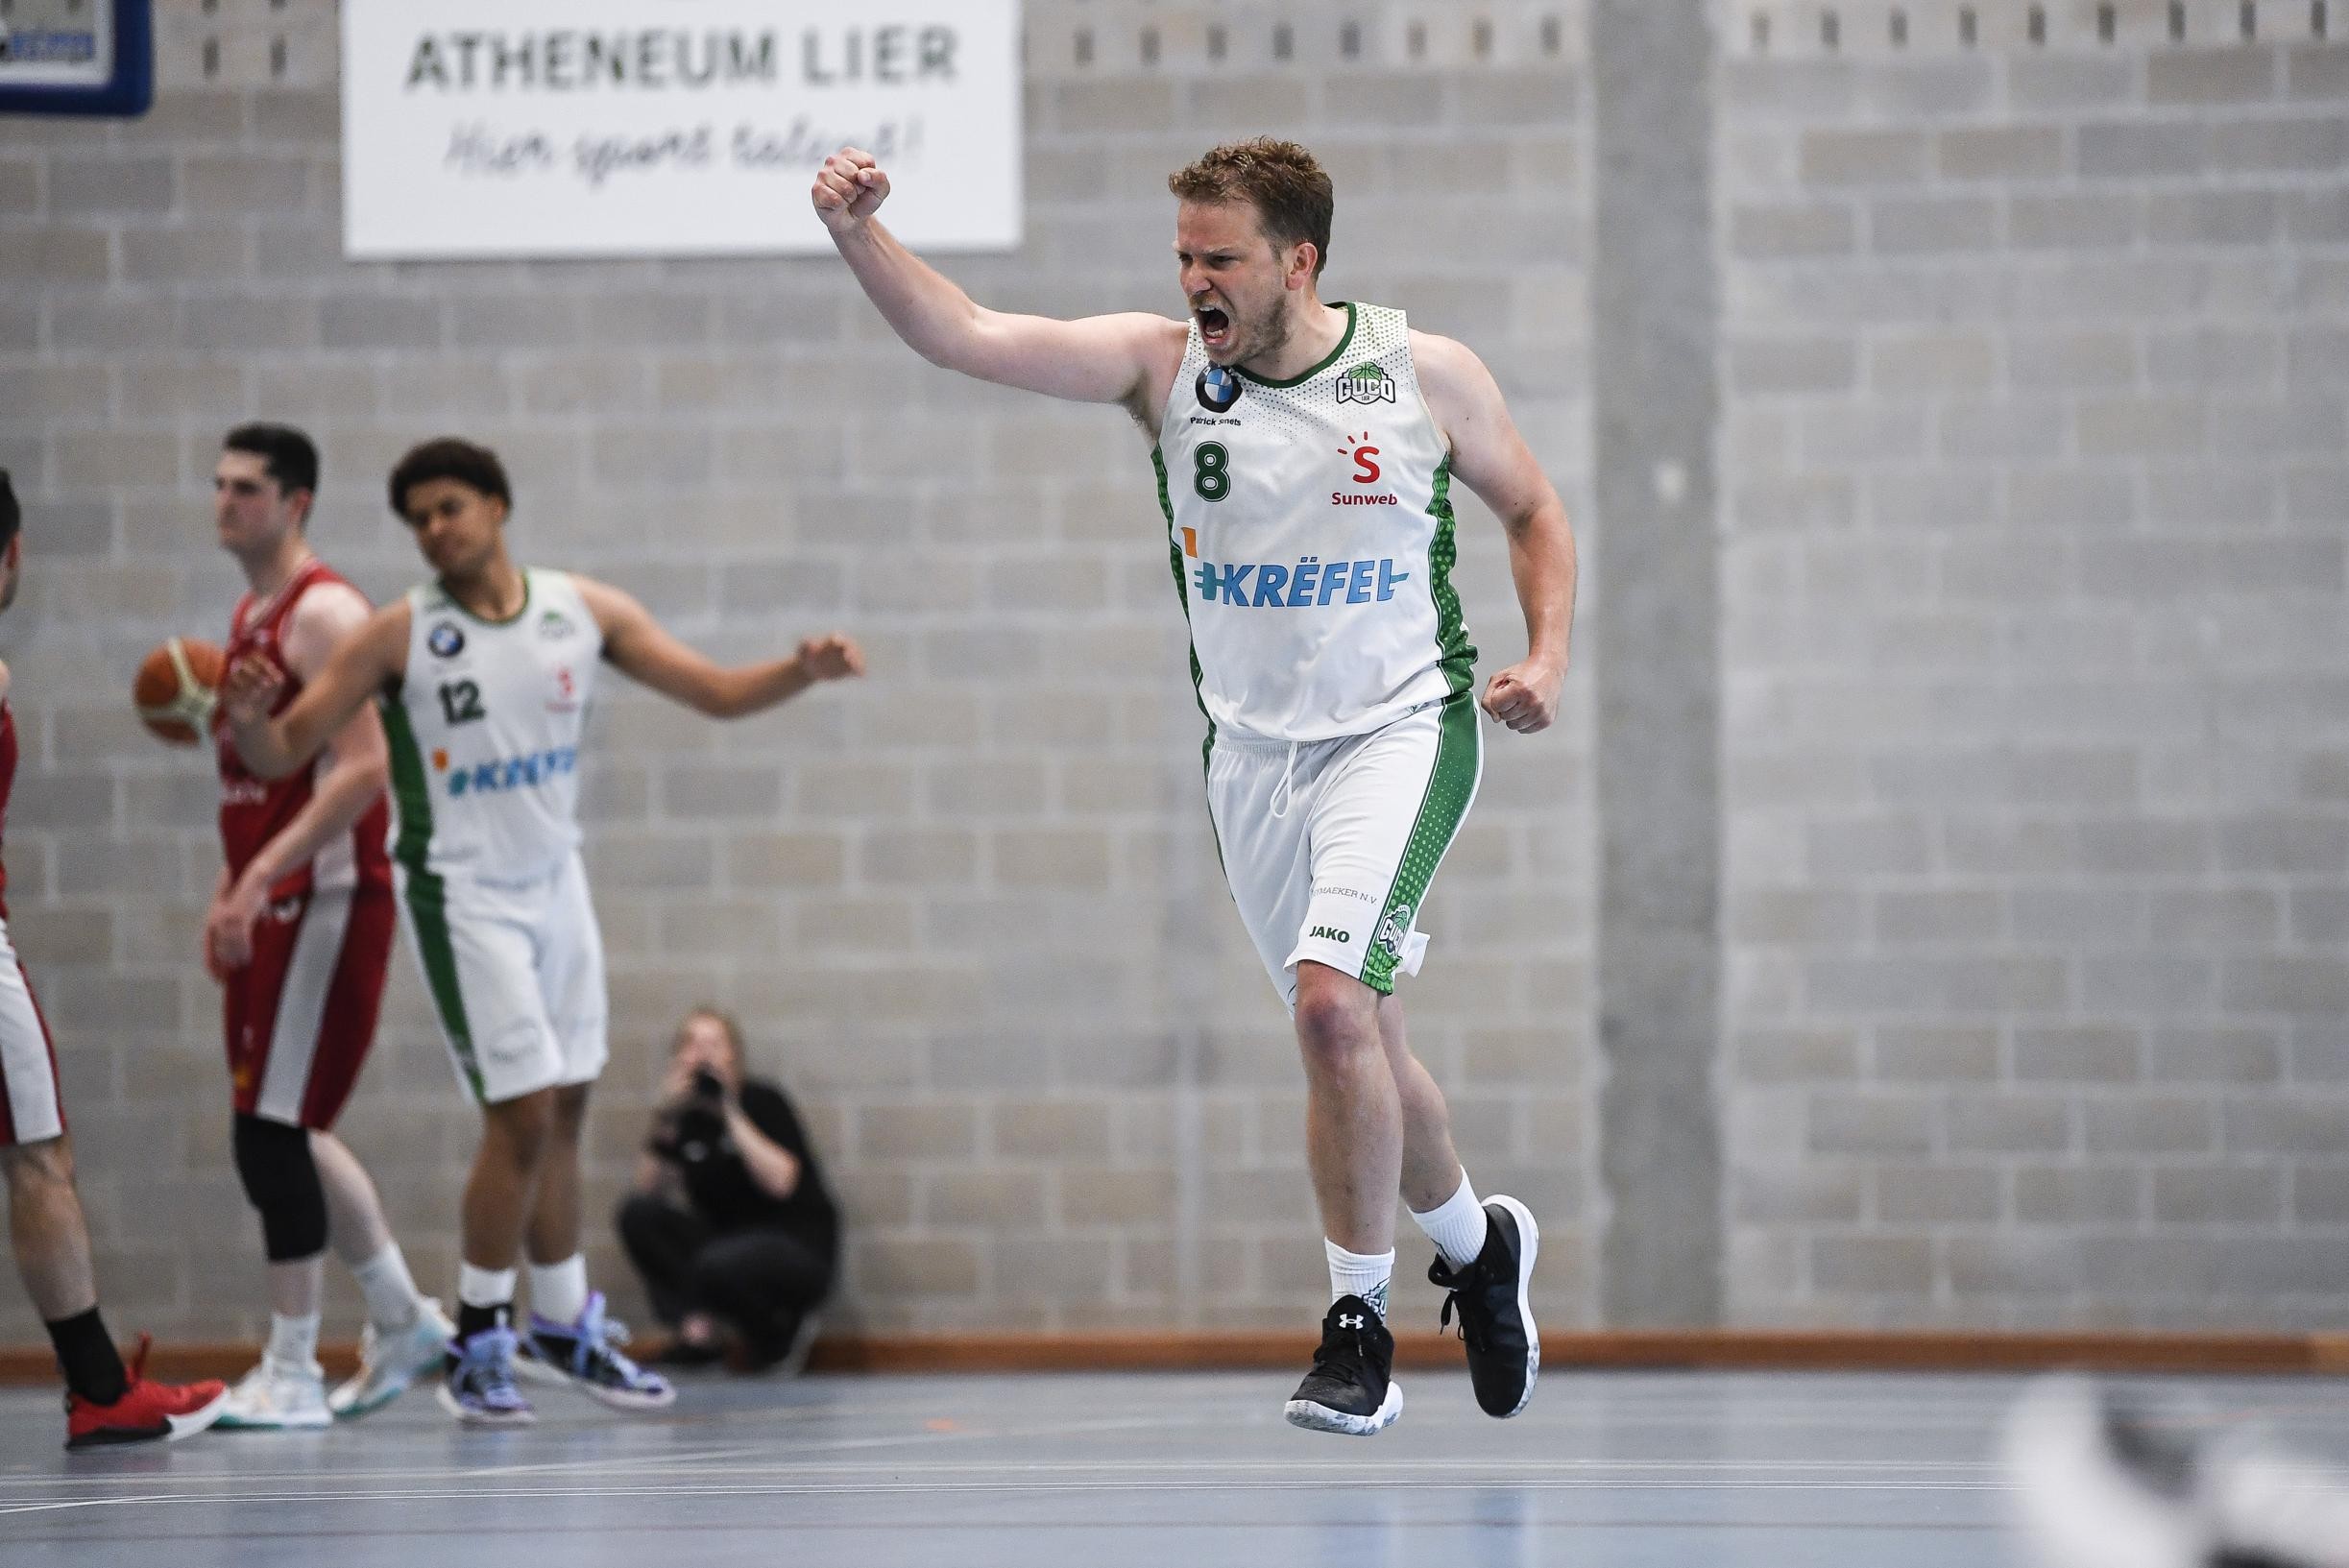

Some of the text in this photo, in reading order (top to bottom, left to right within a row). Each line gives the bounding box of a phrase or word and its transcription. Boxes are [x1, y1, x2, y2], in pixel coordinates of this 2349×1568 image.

[406, 26, 959, 90] ATHENEUM LIER
[1194, 441, 1230, 502] 8
[1331, 492, 1398, 506] Sunweb
[1223, 556, 1394, 608] KRËFEL
[439, 680, 486, 727] 12
[1309, 926, 1350, 943] JAKO
